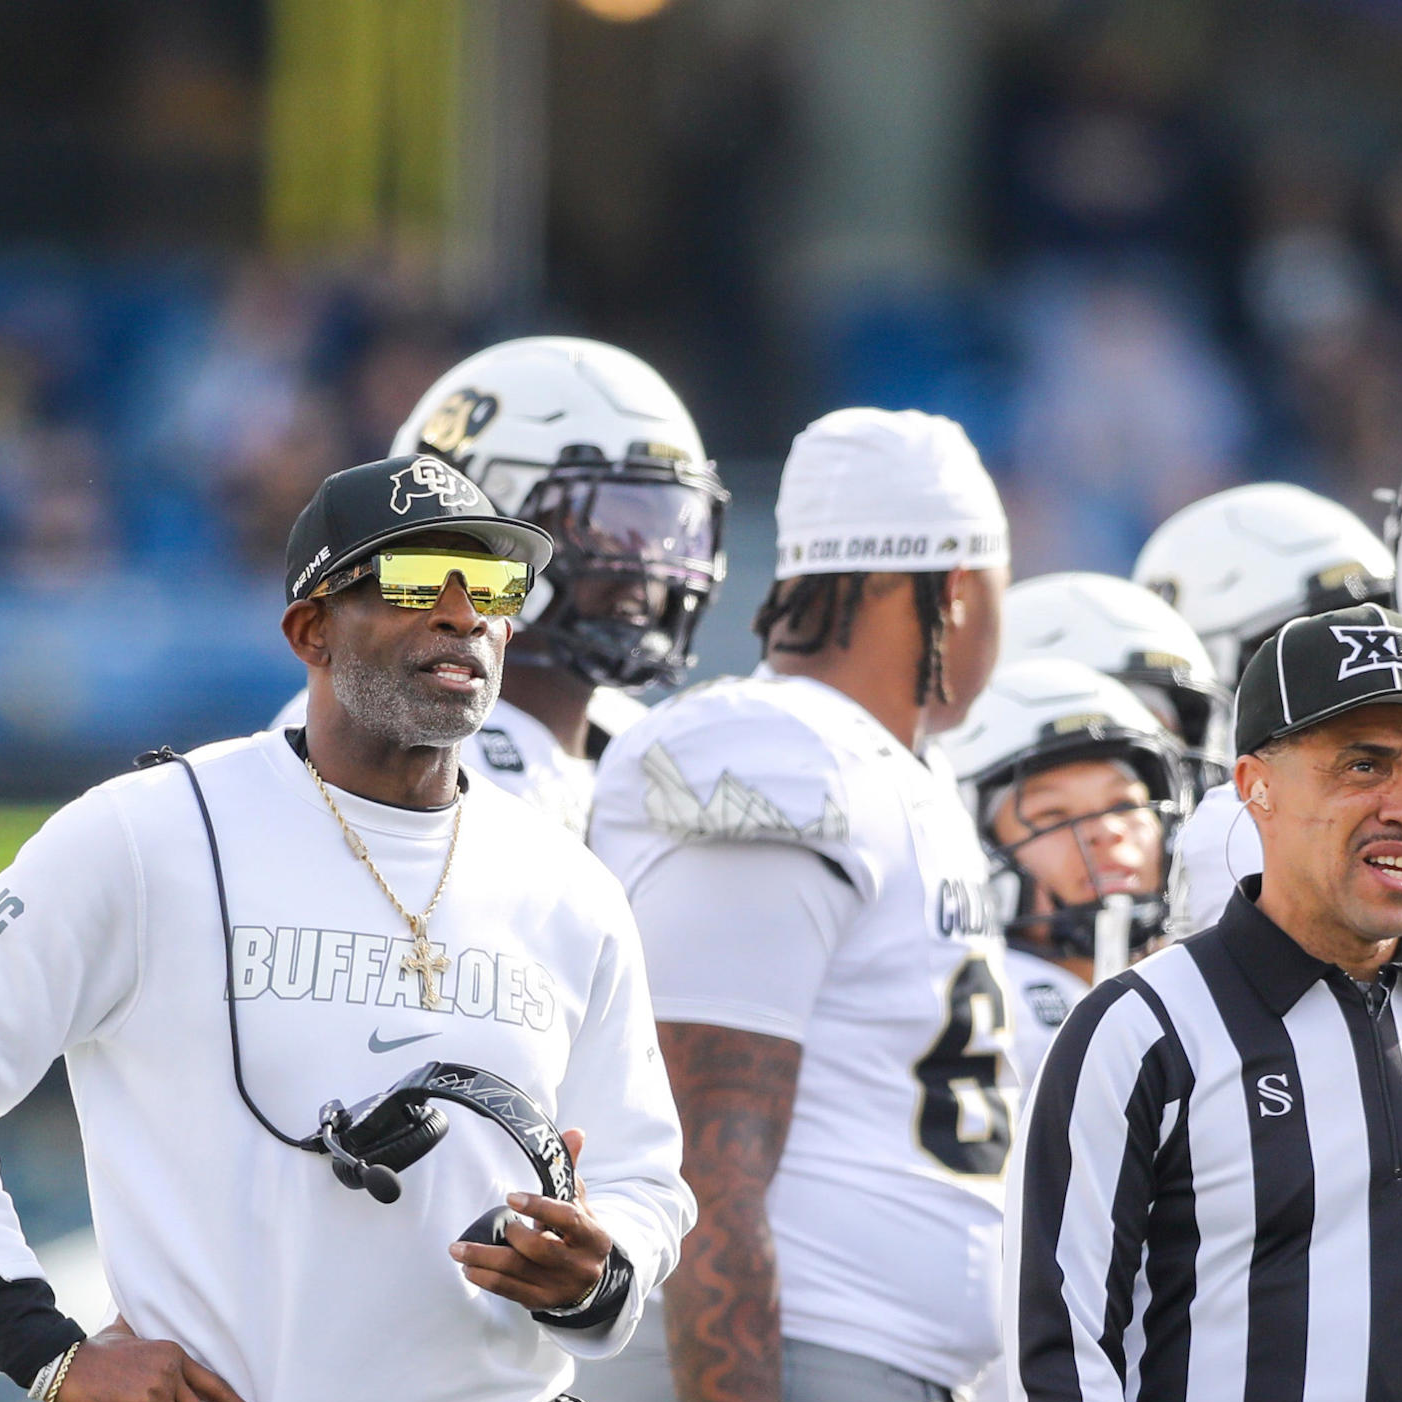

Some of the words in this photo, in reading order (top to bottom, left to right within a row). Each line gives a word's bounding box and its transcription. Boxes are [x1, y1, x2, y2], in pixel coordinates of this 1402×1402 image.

[413, 459, 457, 495] CU
[292, 545, 331, 598] PRIME
[808, 537, 929, 562] COLORADO
[224, 925, 557, 1033] BUFFALOES
[910, 953, 1016, 1184] 6
[1257, 1073, 1294, 1118] S
